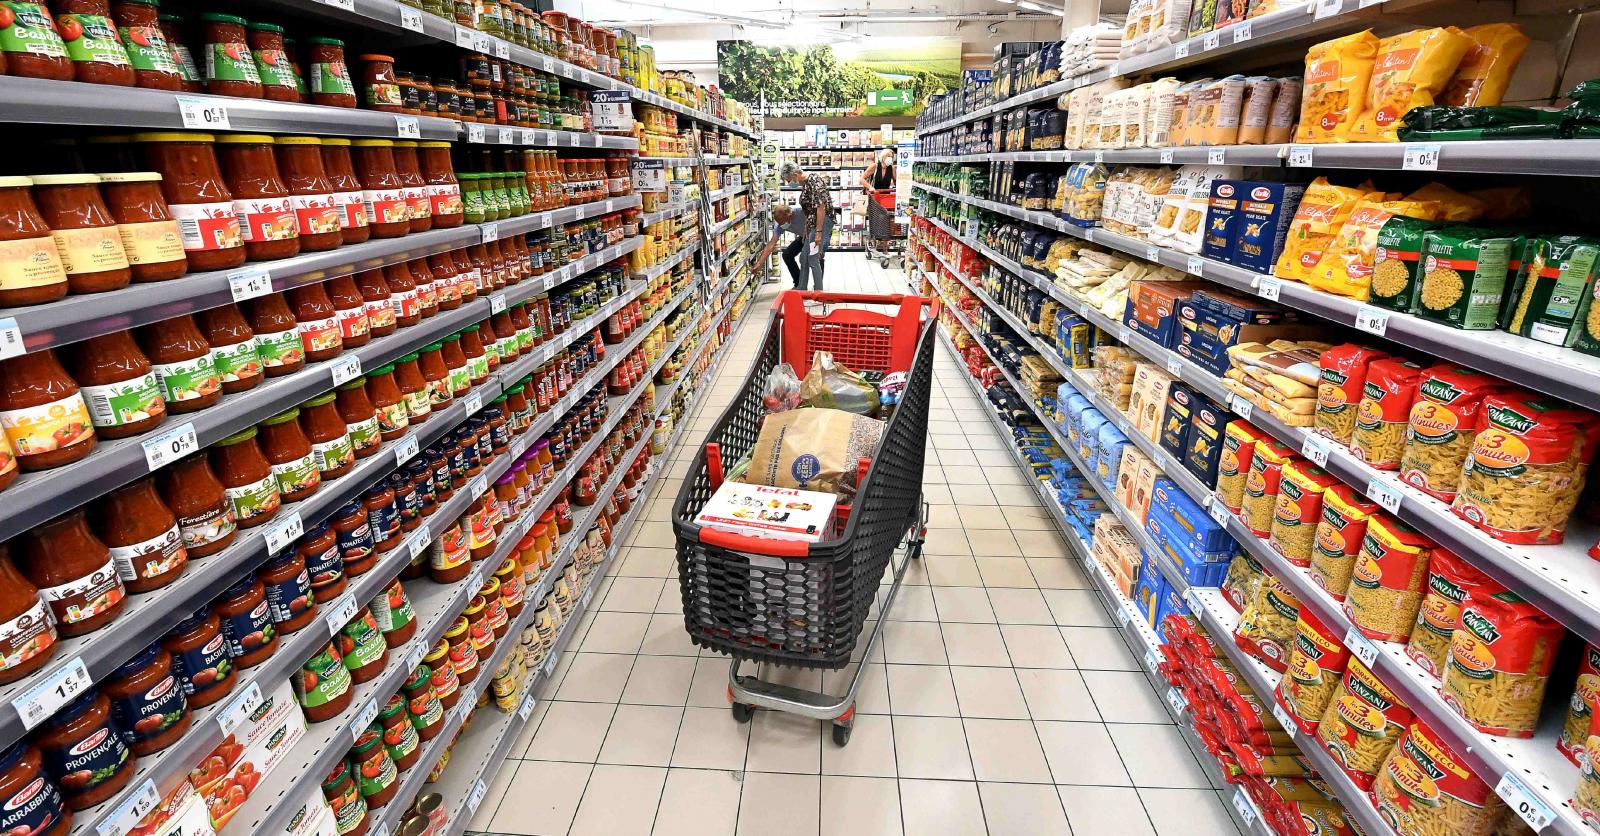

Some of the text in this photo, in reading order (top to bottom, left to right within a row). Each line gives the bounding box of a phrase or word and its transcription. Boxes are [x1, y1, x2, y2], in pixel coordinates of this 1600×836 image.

[1326, 387, 1335, 396] 3
[1421, 382, 1456, 401] PANZANI
[1364, 402, 1372, 412] 3
[1424, 406, 1437, 419] 3
[1411, 413, 1451, 432] Minutes
[1489, 407, 1528, 431] PANZANI
[1487, 434, 1506, 449] 3
[1473, 440, 1521, 464] Minutes
[757, 486, 799, 496] Tefal
[1280, 498, 1288, 508] 3
[178, 507, 220, 527] Forestière
[1324, 527, 1333, 538] 3
[1360, 556, 1369, 567] 3
[1430, 576, 1466, 600] PANZANI
[1420, 603, 1455, 625] Minute
[1433, 601, 1446, 613] 3
[1451, 640, 1489, 669] Minutes
[1463, 638, 1476, 652] 3
[1290, 663, 1314, 680] nutes
[1295, 657, 1308, 668] 3
[1351, 663, 1378, 689] FORMAT
[1350, 679, 1387, 711] PANZANI
[1336, 699, 1377, 731] Minutes
[1356, 703, 1371, 718] 3
[79, 728, 109, 751] Barilla
[65, 731, 118, 771] PROVENÇALE
[1404, 740, 1439, 780] PANZANI
[1433, 751, 1457, 772] ECO
[1388, 758, 1429, 800] Minutes
[1411, 767, 1425, 785] 3
[14, 777, 44, 805] Barilla
